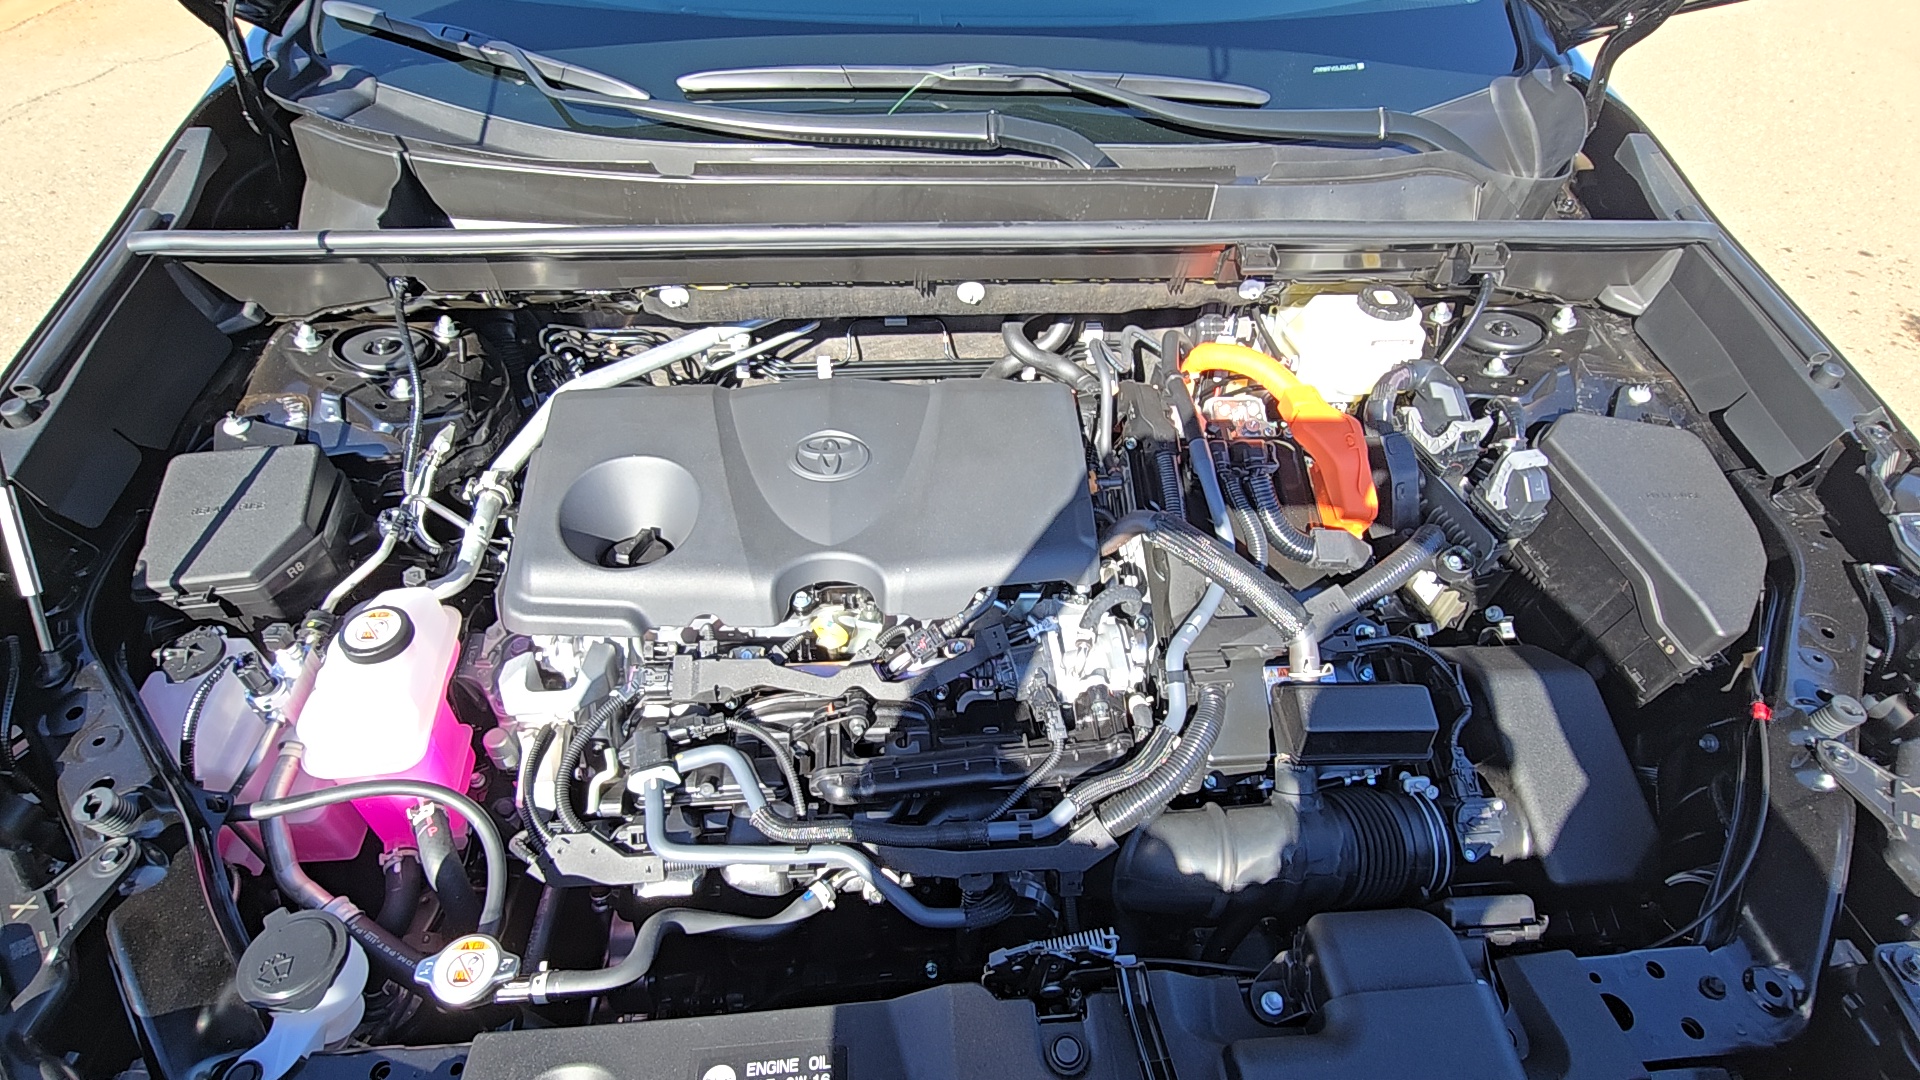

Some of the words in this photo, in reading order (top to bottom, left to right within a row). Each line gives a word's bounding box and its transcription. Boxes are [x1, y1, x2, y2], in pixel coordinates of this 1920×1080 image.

[286, 561, 305, 579] R8
[746, 1057, 800, 1077] ENGINE
[808, 1054, 831, 1071] OIL
